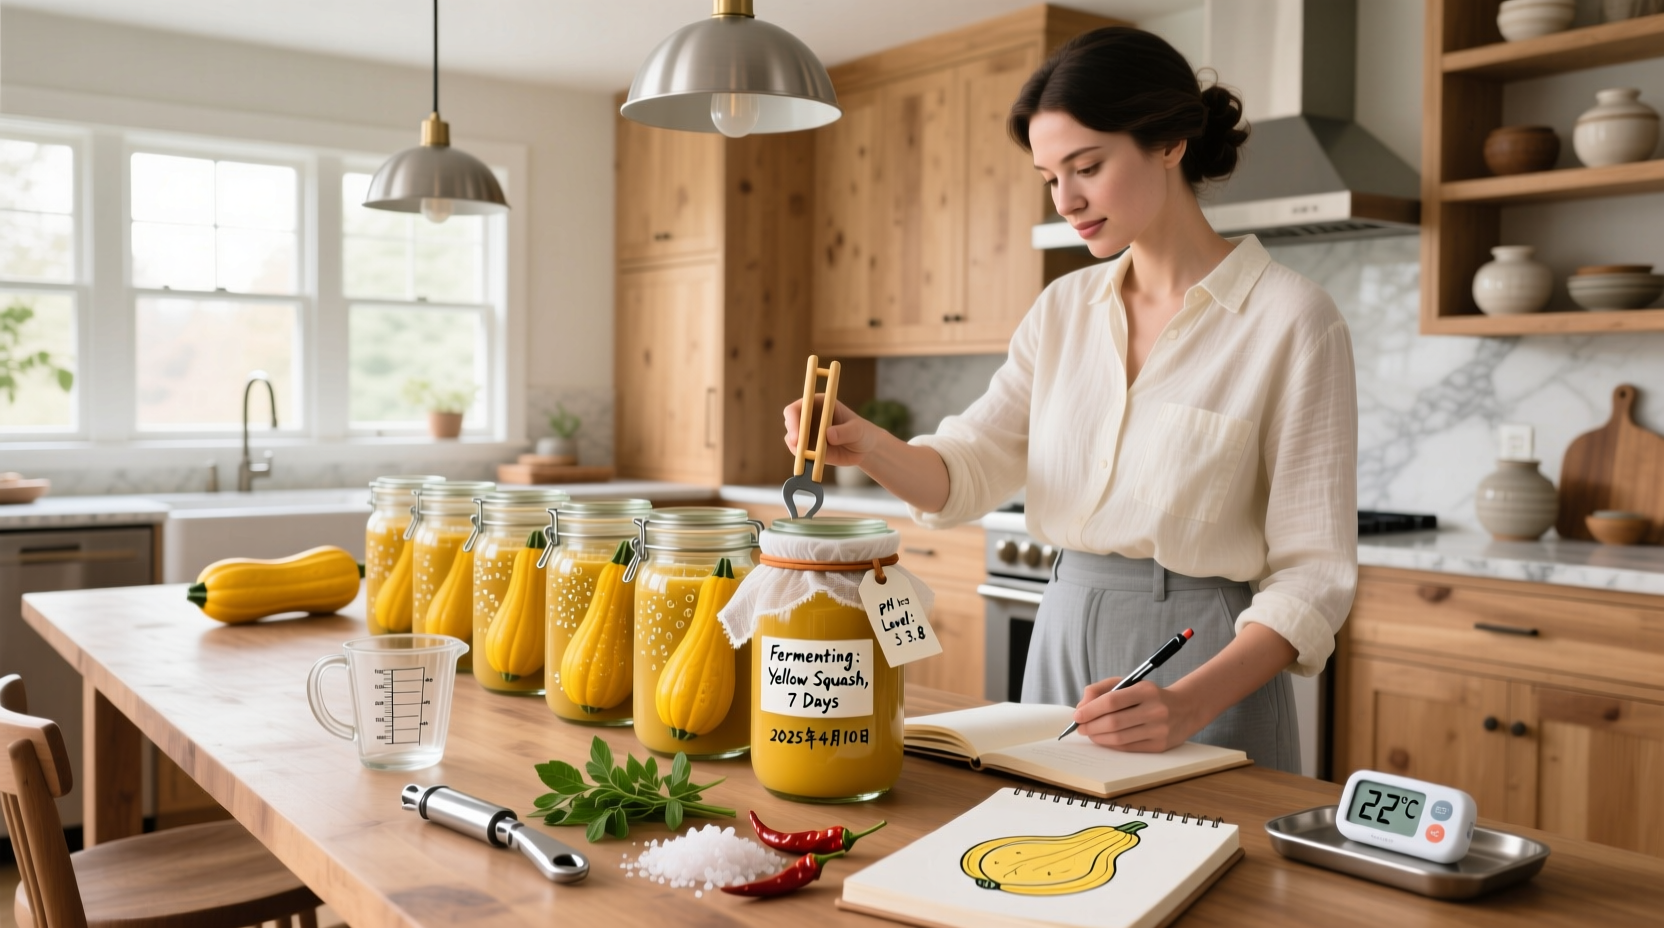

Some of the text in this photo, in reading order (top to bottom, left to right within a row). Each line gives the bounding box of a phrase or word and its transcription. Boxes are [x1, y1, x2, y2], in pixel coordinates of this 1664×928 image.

[770, 644, 860, 671] Fermenting:
[768, 666, 869, 691] Yellow Squash,
[788, 692, 839, 714] 7 Days
[769, 726, 869, 750] 2025年4月10日
[1359, 789, 1419, 825] 22°C
